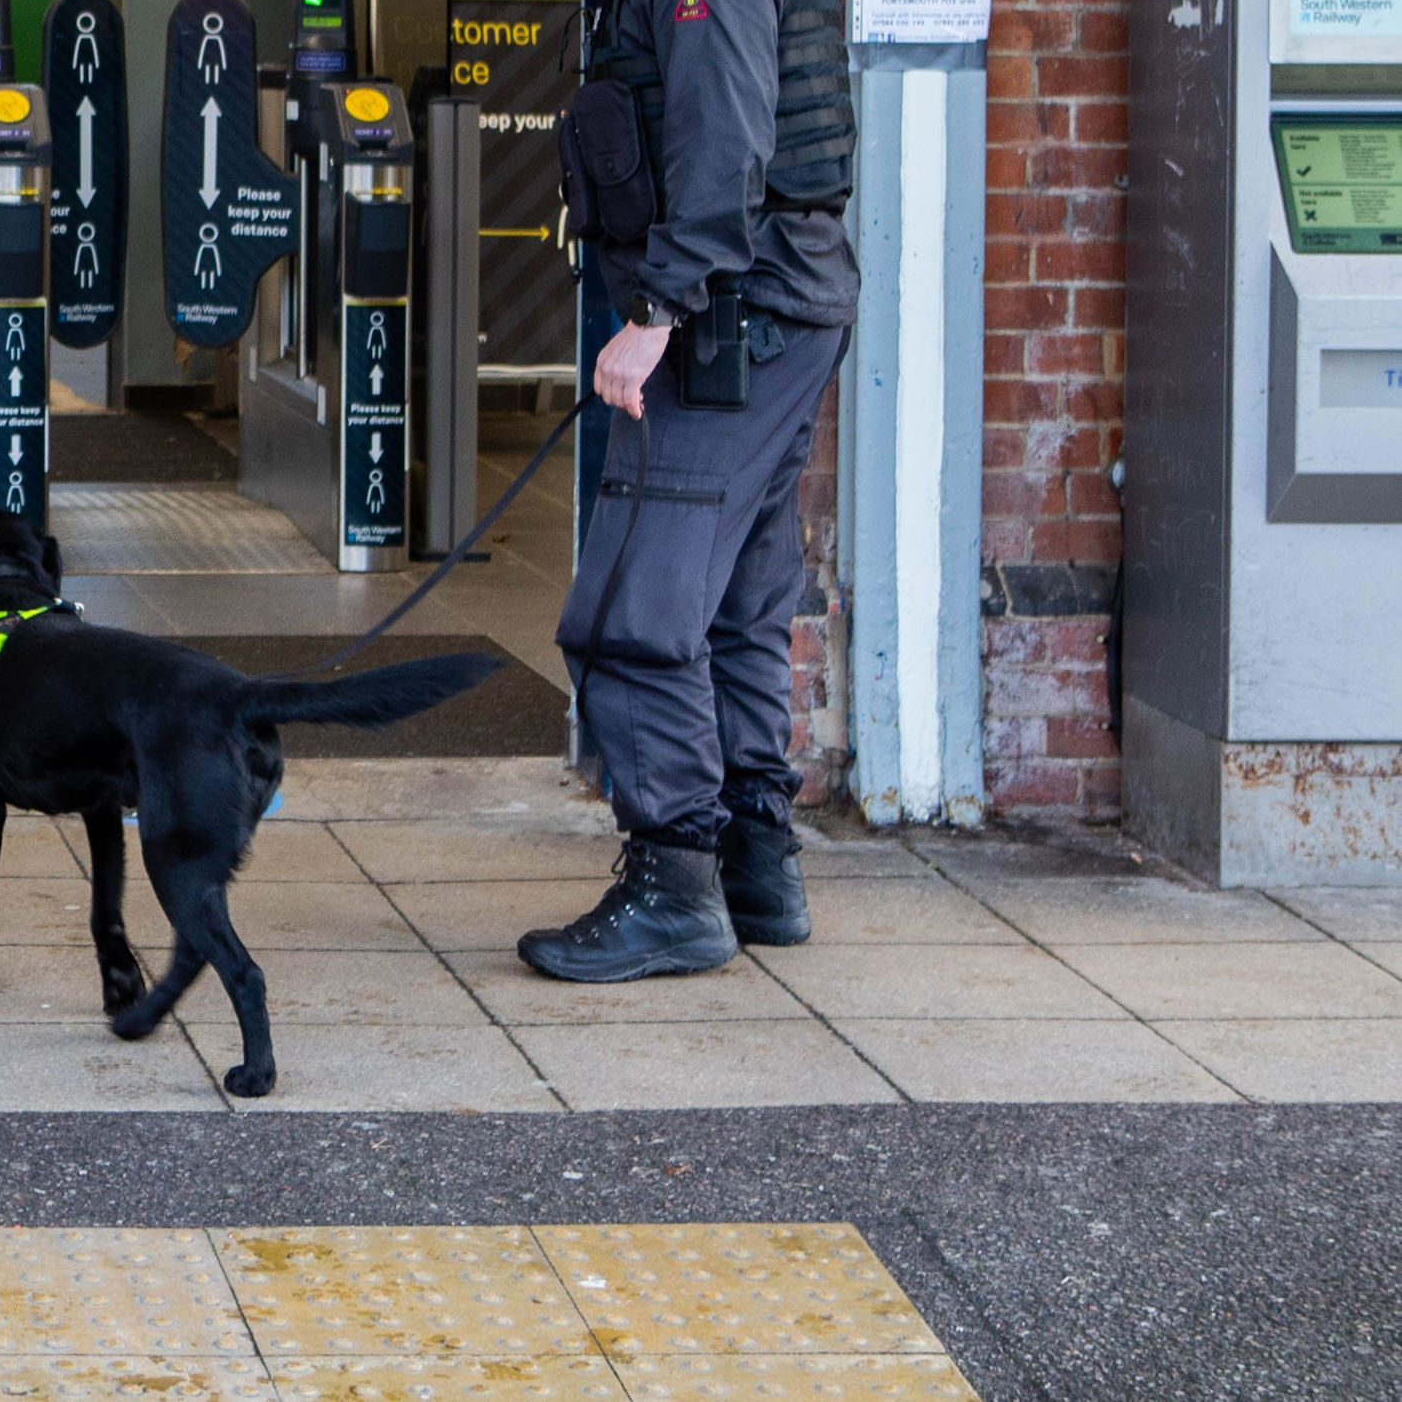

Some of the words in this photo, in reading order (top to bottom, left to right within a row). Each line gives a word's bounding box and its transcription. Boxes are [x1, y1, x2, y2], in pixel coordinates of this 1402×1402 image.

[1313, 11, 1363, 26] Railway
[514, 113, 556, 134] your
[237, 187, 282, 202] Please
[50, 206, 71, 217] our
[227, 204, 259, 221] keep
[261, 208, 293, 222] your
[231, 223, 288, 238] distance
[20, 406, 41, 417] keep
[350, 402, 380, 413] Please
[380, 404, 402, 415] keep
[8, 418, 45, 427] distance
[347, 417, 368, 427] your
[368, 415, 405, 425] distance
